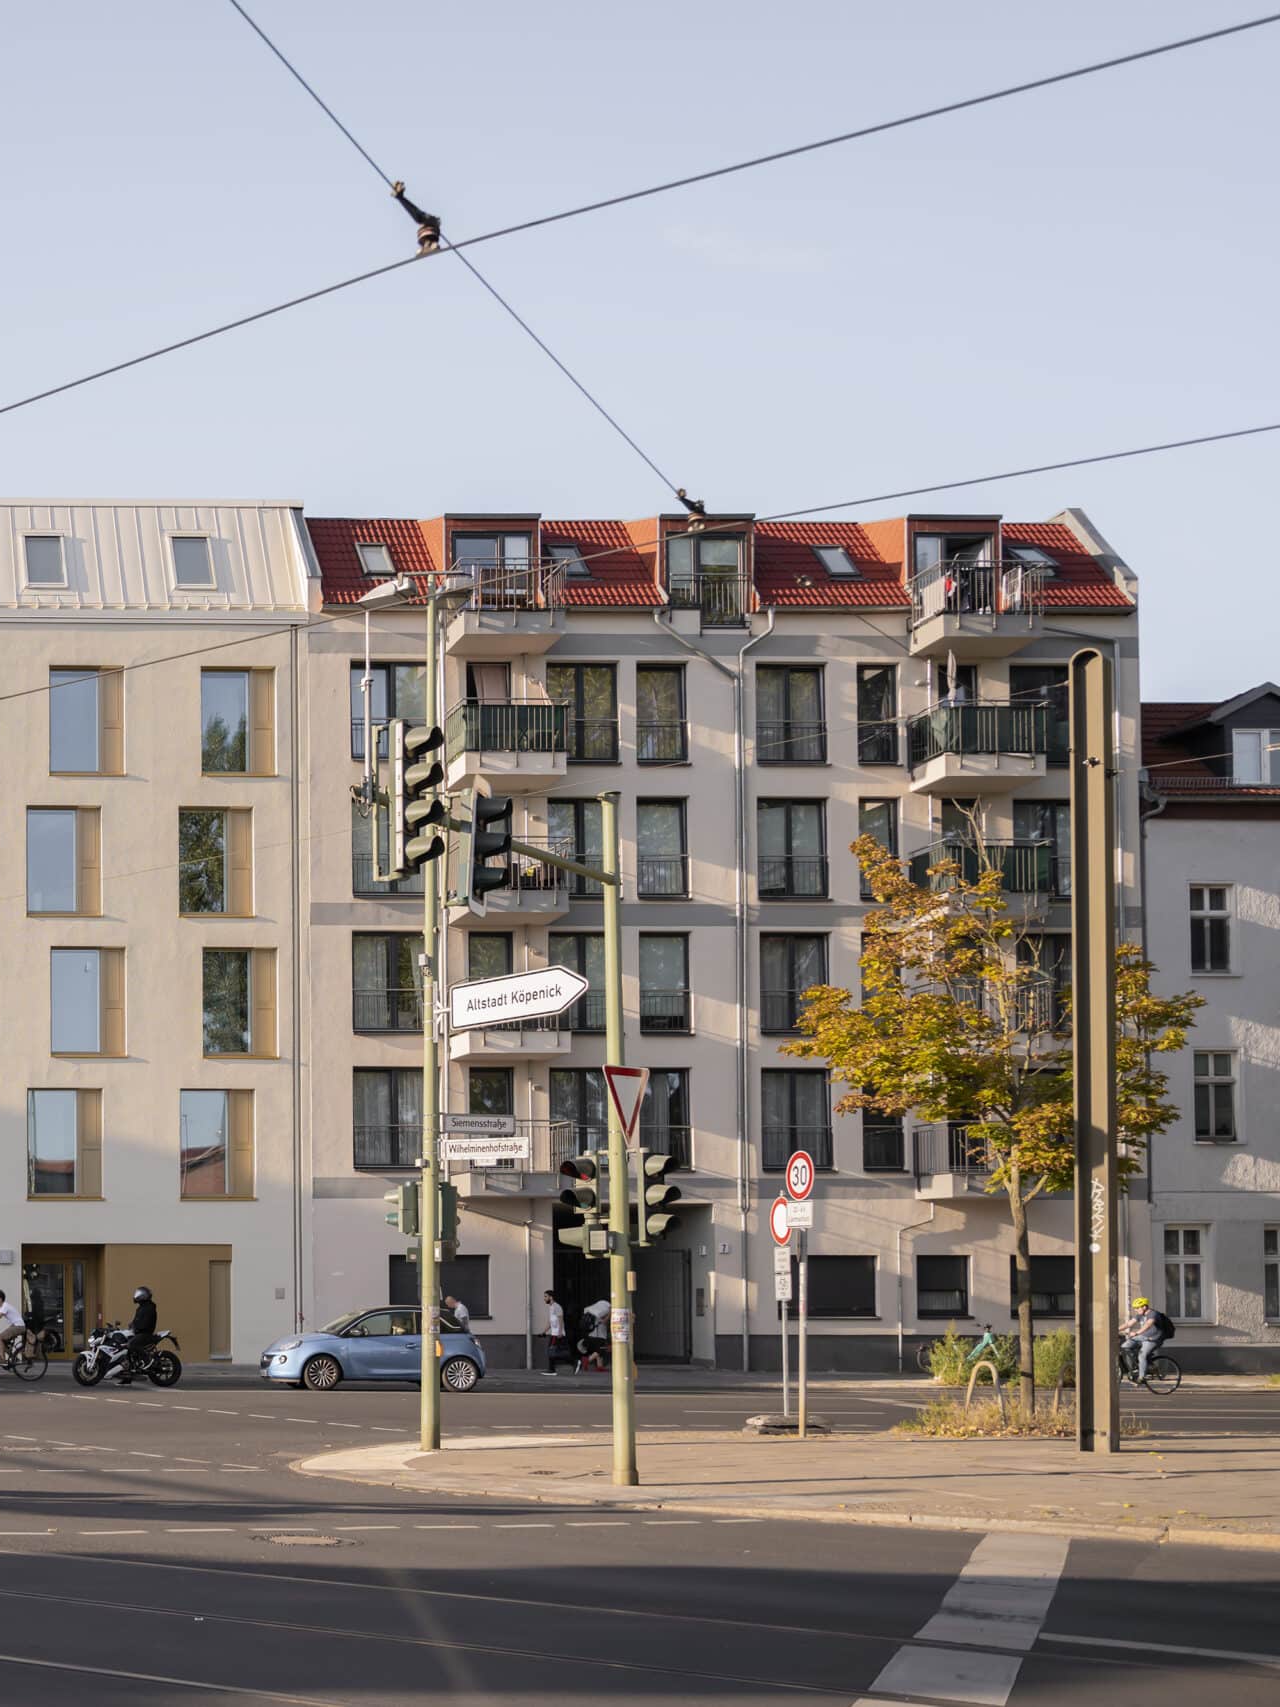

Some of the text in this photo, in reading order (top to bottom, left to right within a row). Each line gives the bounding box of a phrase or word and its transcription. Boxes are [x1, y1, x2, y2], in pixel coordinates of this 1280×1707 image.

[466, 984, 563, 1012] Altstadt Köpenick
[451, 1117, 507, 1130] Siemensstraße
[448, 1141, 523, 1153] Wilhelminenhofstraße
[792, 1164, 808, 1187] 30
